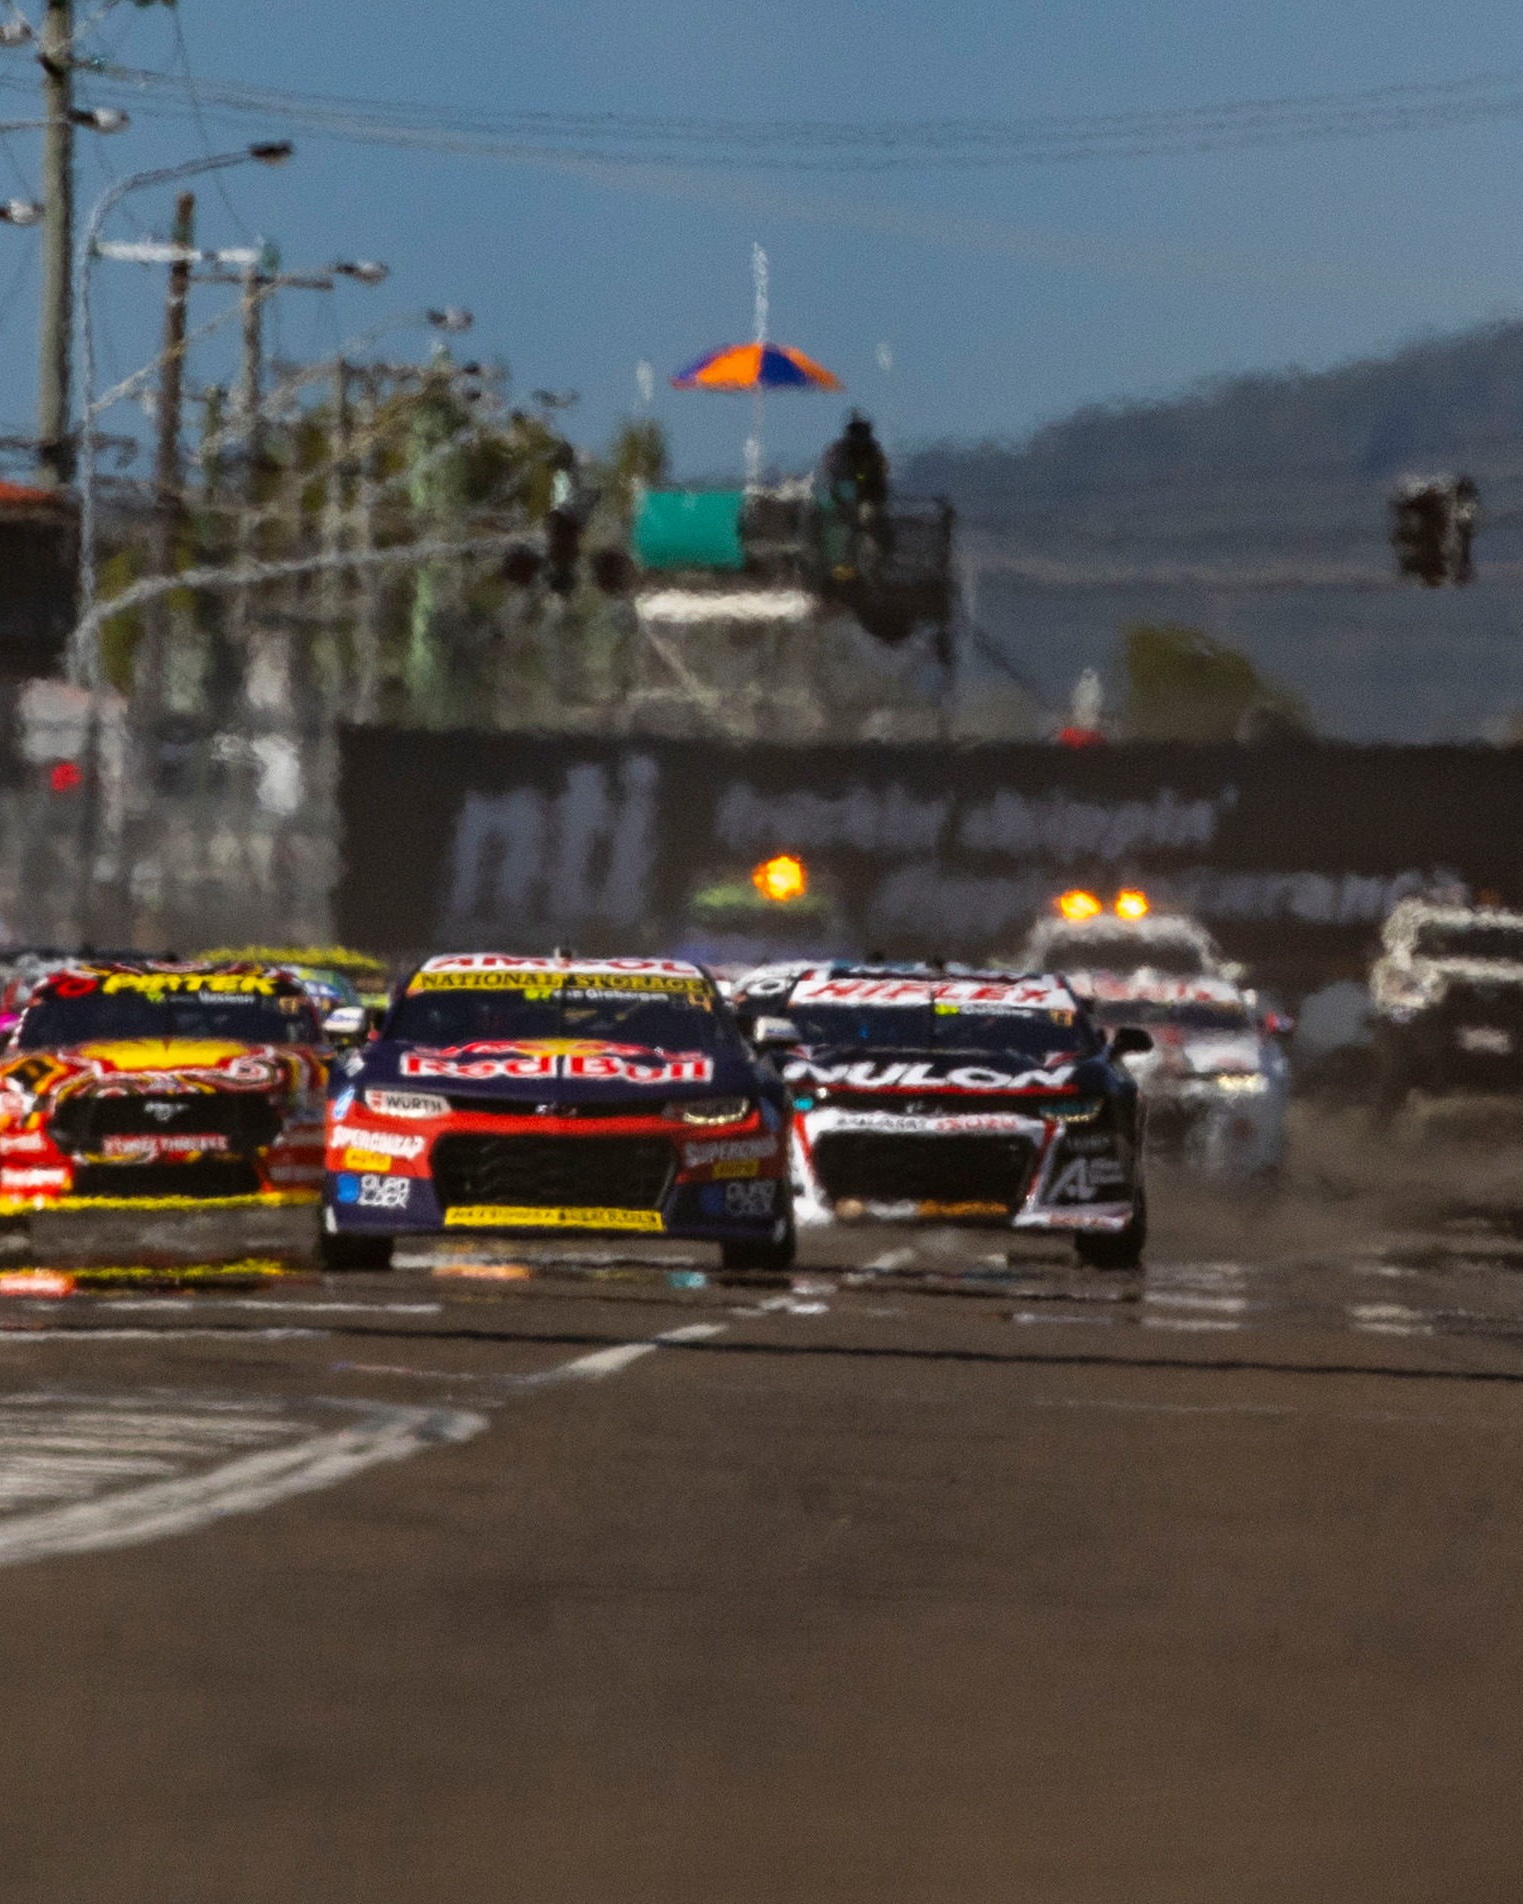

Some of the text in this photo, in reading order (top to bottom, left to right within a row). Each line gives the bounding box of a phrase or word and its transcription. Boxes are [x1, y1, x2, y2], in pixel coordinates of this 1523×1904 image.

[421, 972, 563, 988] NATIONAL
[402, 1053, 714, 1084] Red Bull
[782, 1061, 1074, 1088] NULON
